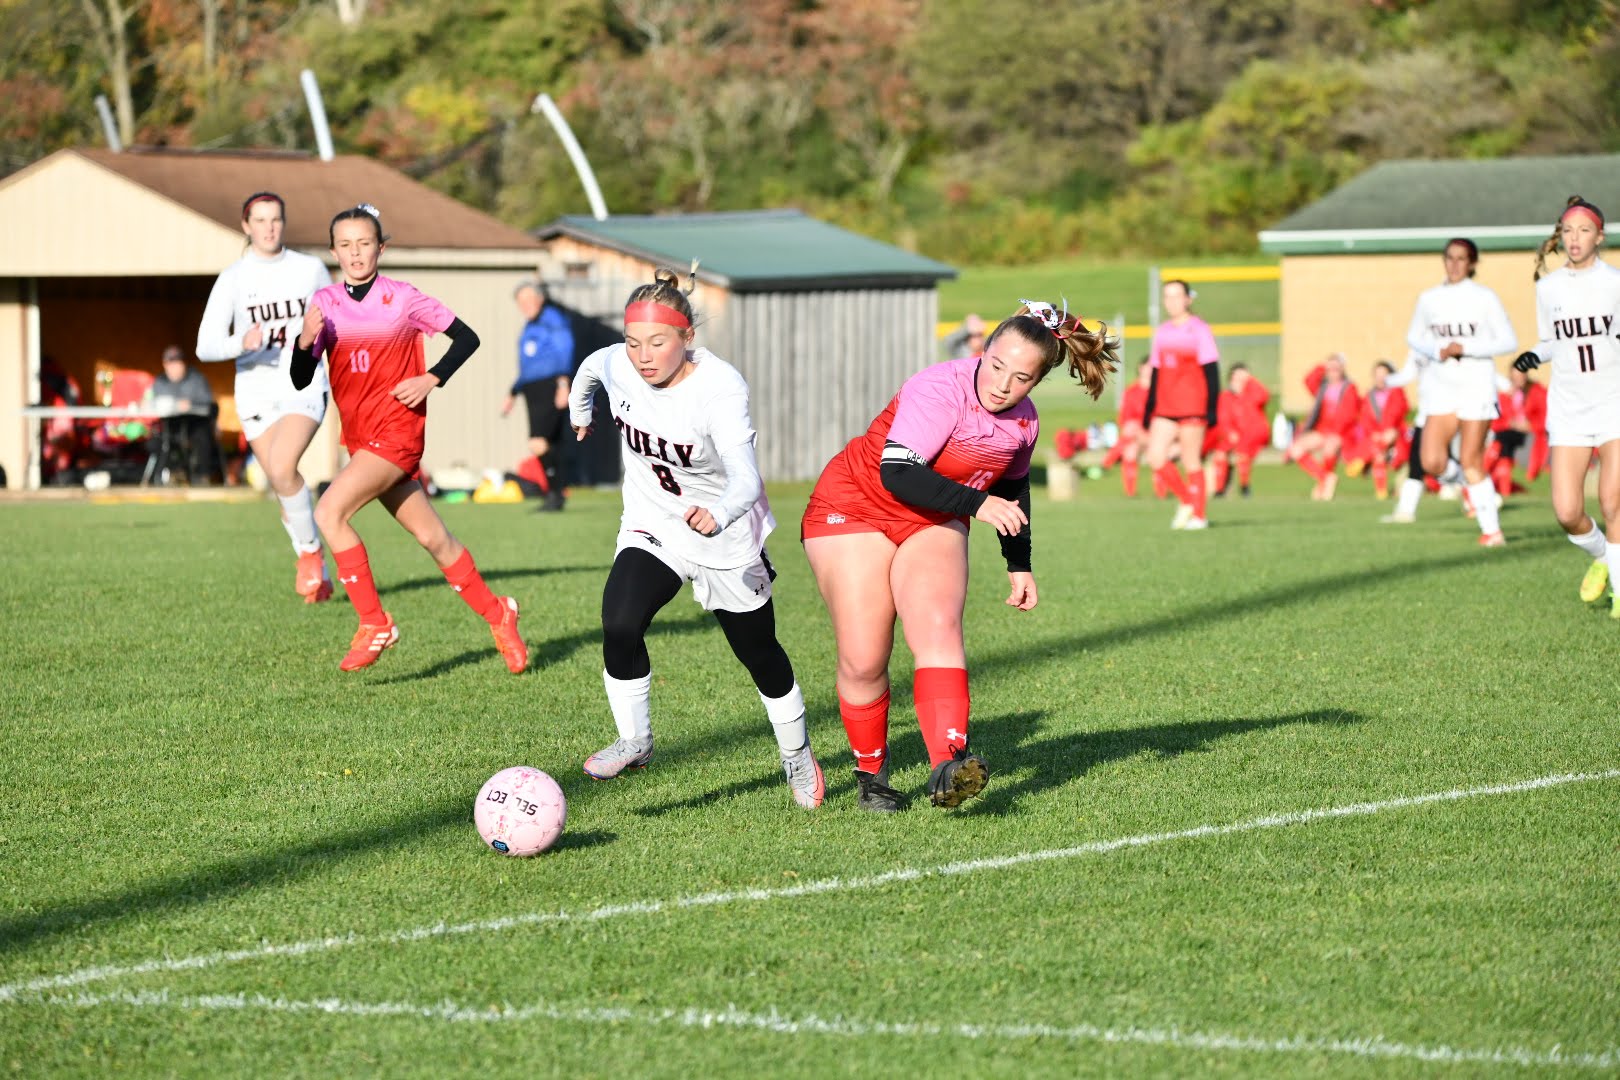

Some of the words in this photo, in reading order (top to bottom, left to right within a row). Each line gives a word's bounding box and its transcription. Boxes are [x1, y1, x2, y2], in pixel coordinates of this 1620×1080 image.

[247, 298, 307, 323] TULLY
[266, 325, 286, 350] 14
[1430, 322, 1478, 338] TULLY
[1554, 315, 1613, 340] TULLY
[350, 349, 370, 373] 10
[1578, 344, 1595, 373] 11
[651, 463, 682, 496] 8
